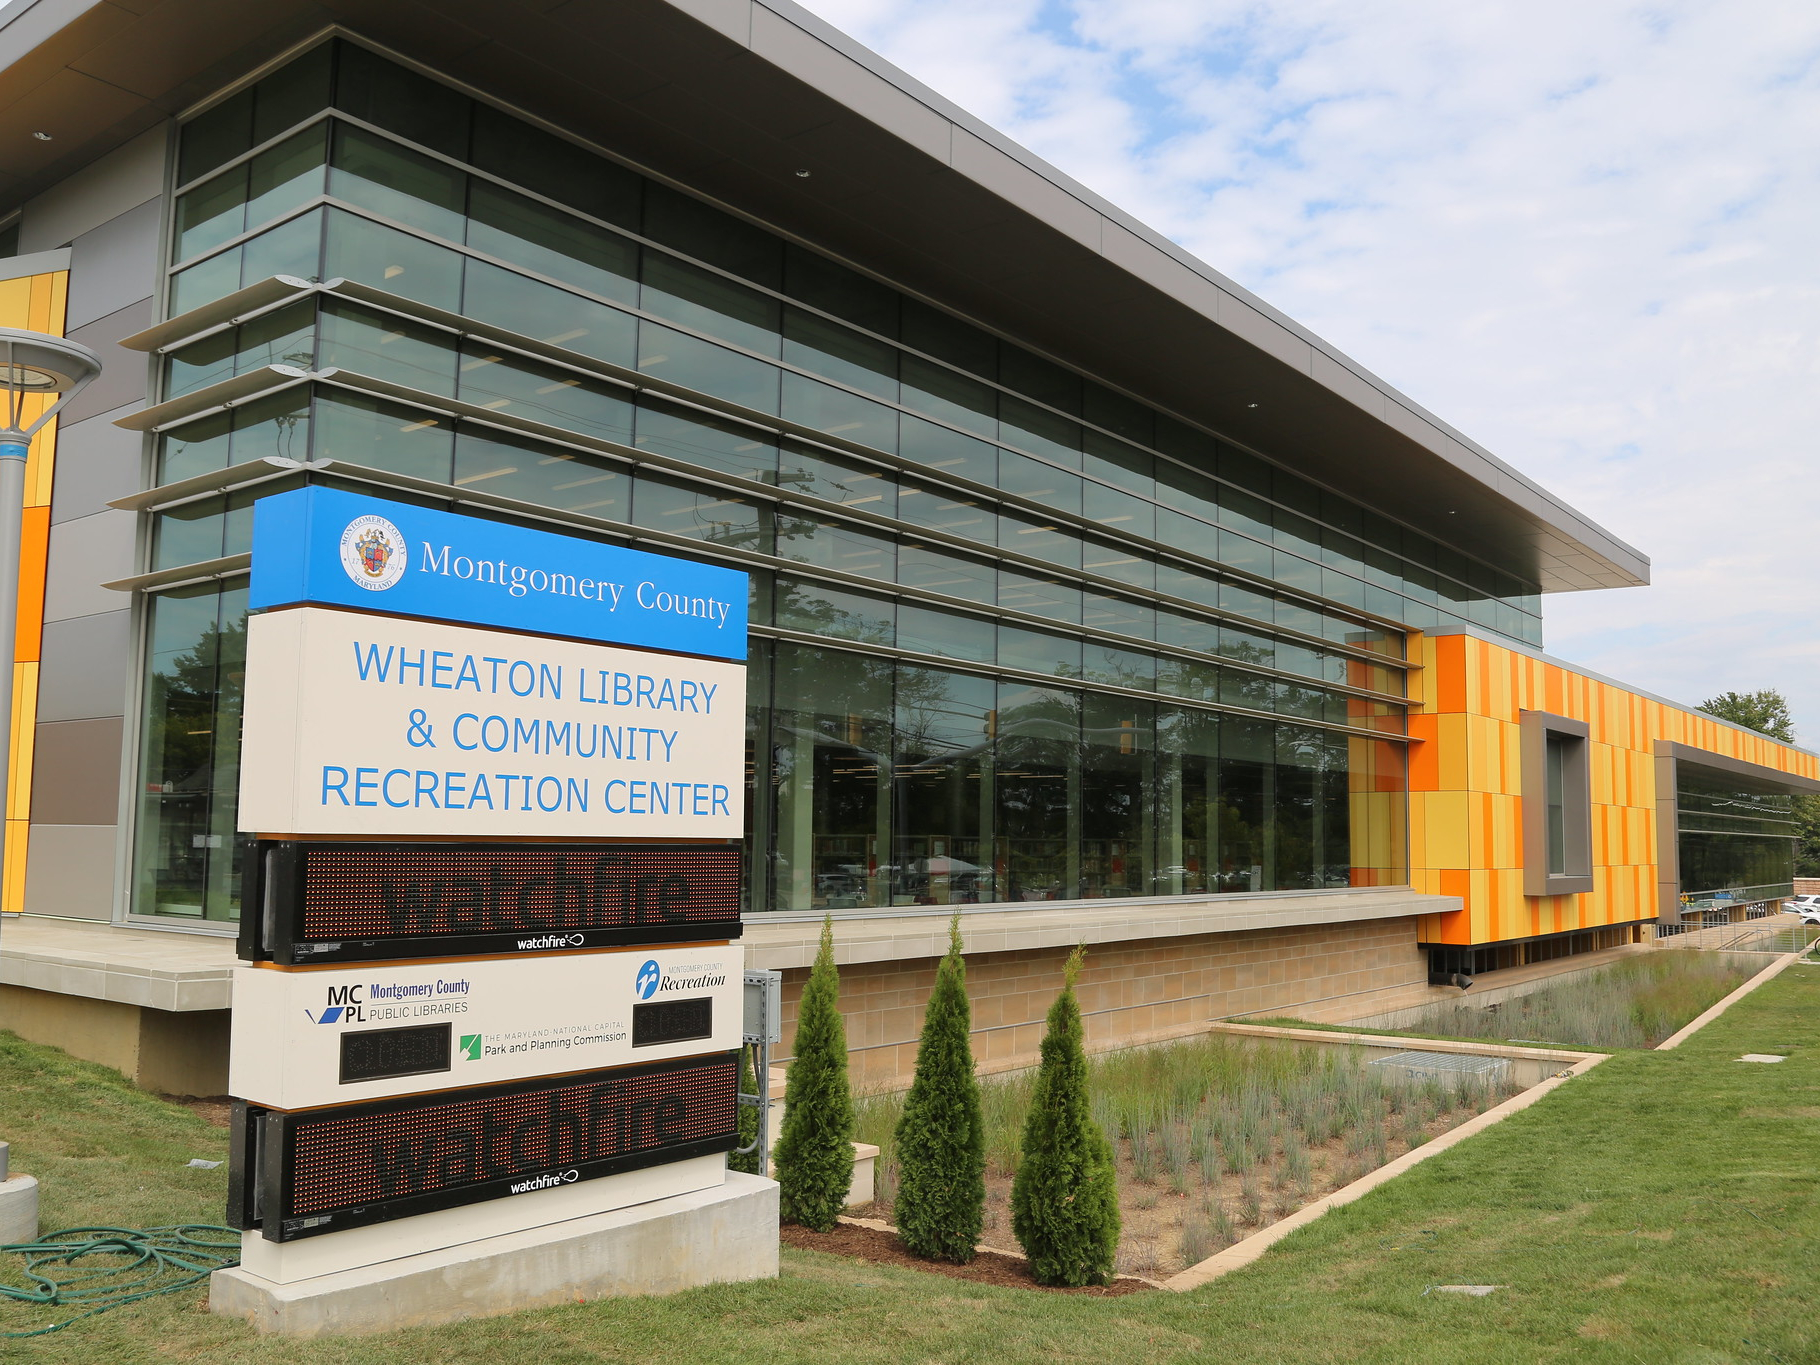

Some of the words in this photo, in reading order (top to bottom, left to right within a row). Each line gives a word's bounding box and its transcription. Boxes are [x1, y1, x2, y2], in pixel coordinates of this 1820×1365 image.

[341, 516, 387, 547] MONTGOMERY
[387, 524, 406, 557] COUNTY
[354, 575, 393, 590] MARYLAND
[419, 541, 624, 612] Montgomery
[636, 581, 731, 629] County
[353, 641, 563, 700] WHEATON
[579, 668, 718, 715] LIBRARY
[406, 708, 437, 748] &
[452, 713, 678, 763] COMMUNITY
[321, 765, 589, 813] RECREATION
[603, 779, 731, 816] CENTER
[668, 964, 703, 974] MONTGOMERY
[703, 963, 724, 972] COUNTY
[370, 983, 433, 1000] Montgomery
[436, 979, 470, 995] County
[659, 972, 726, 991] Recreation
[327, 984, 363, 1006] MC
[345, 1006, 366, 1023] PL
[370, 1006, 410, 1021] PUBLIC
[413, 1002, 468, 1017] LIBRARIES
[485, 1034, 501, 1042] THE
[504, 1024, 592, 1041] MARYLAND-NATIONAL
[594, 1021, 624, 1031] CAPITAL
[484, 1044, 507, 1056] Park
[509, 1041, 527, 1053] and
[530, 1037, 571, 1051] Planning
[573, 1031, 627, 1046] Commission
